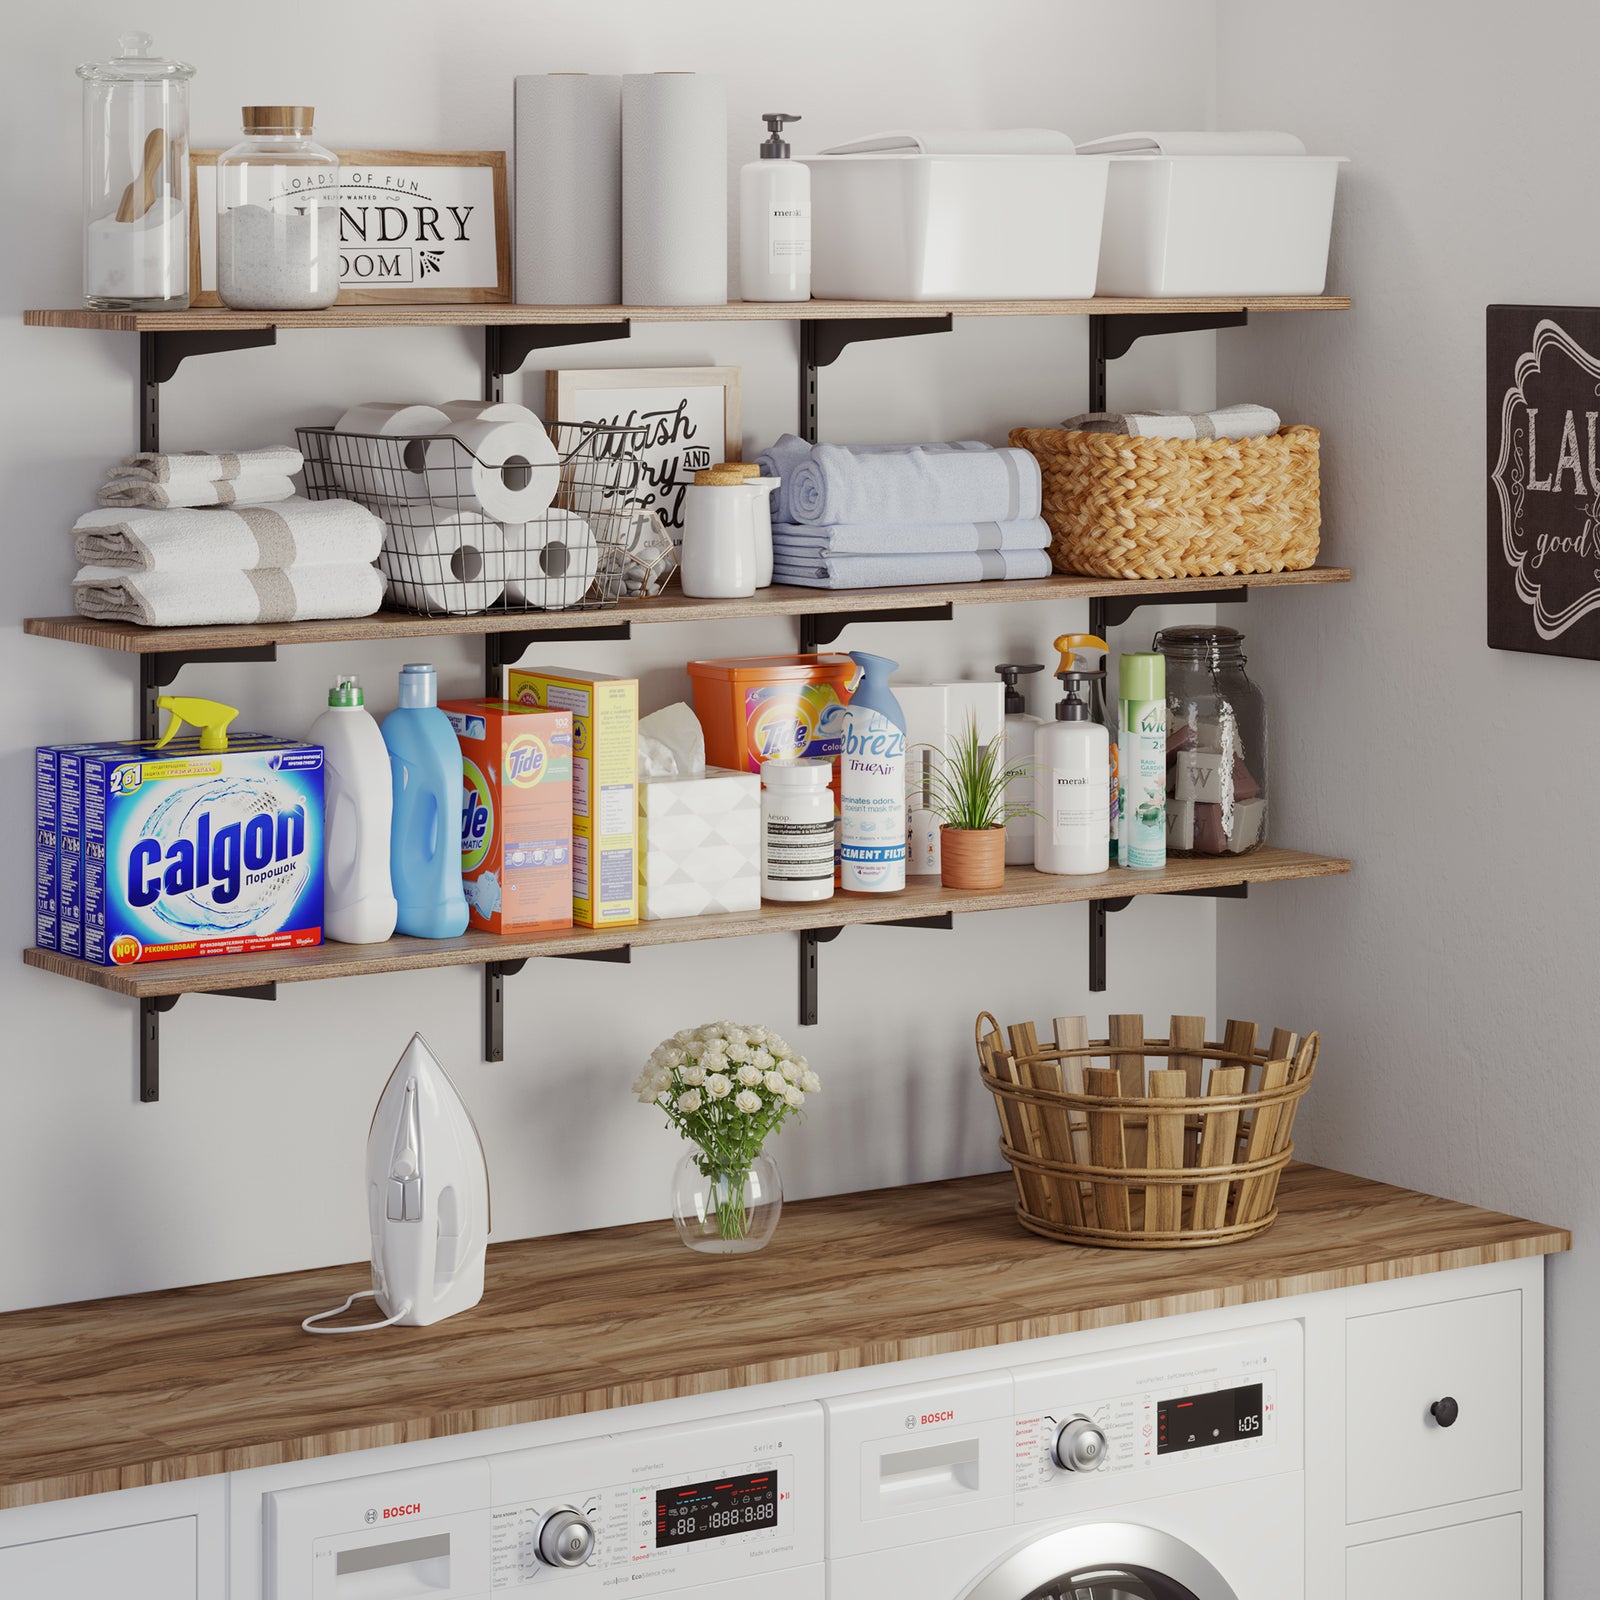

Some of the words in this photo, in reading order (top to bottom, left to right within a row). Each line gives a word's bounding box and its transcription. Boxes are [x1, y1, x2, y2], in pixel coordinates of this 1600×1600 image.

[352, 172, 373, 184] OF
[386, 176, 419, 191] FUN
[580, 398, 697, 461] Wash
[602, 451, 694, 498] Dry
[683, 450, 710, 468] AND
[620, 485, 687, 552] Fol
[1531, 519, 1592, 569] good
[555, 718, 569, 727] 102
[760, 718, 808, 755] Tide
[509, 747, 544, 780] Tide
[1187, 766, 1213, 789] W
[1057, 777, 1088, 785] meraki
[462, 791, 488, 838] de
[128, 803, 305, 908] Calgon
[842, 848, 881, 860] CEMENT
[245, 861, 296, 887] Порошок
[920, 1410, 954, 1426] BOSCH
[1238, 1414, 1259, 1432] 1:05
[383, 1502, 421, 1519] BOSCH
[677, 1517, 695, 1535] 88
[744, 1502, 774, 1523] 8:88
